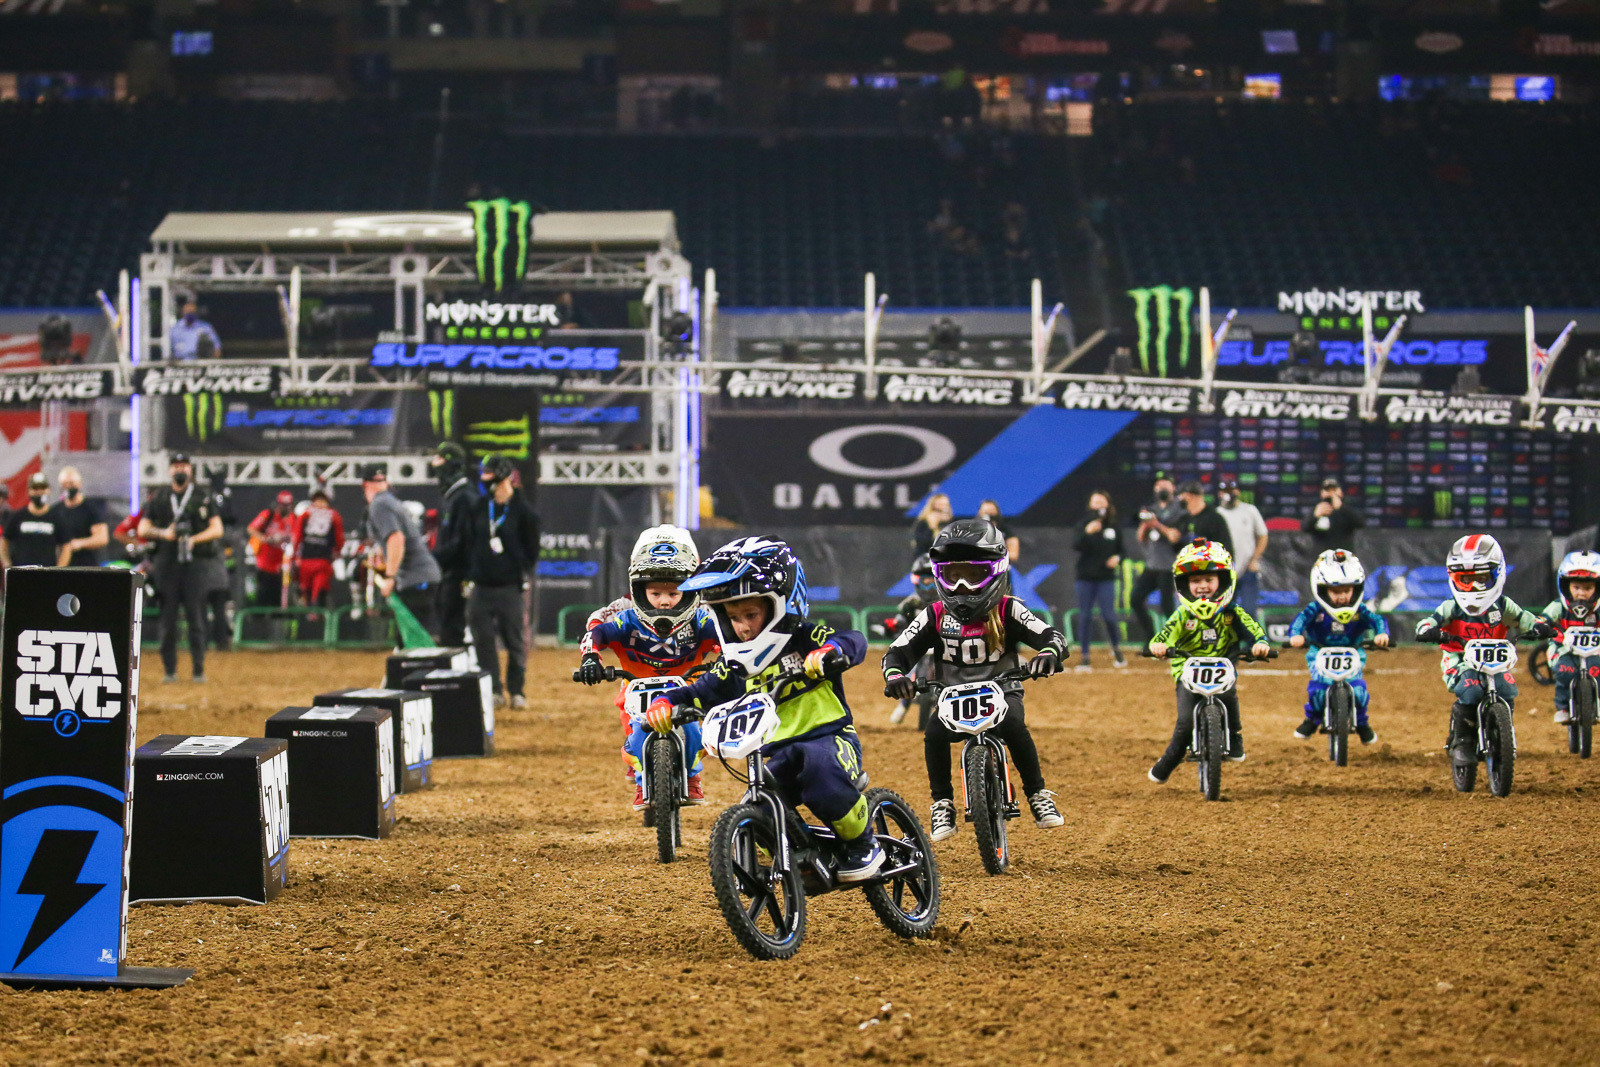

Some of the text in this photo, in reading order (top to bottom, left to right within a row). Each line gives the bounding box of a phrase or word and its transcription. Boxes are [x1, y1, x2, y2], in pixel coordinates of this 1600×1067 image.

[426, 299, 559, 326] MONSTER
[447, 326, 543, 339] ENERGY
[773, 483, 918, 509] OAKL
[1572, 634, 1600, 647] 109
[17, 630, 117, 675] STA
[1325, 657, 1352, 670] 103
[1192, 667, 1227, 684] 102
[15, 673, 121, 719] CYC
[950, 694, 995, 722] 105
[298, 730, 348, 738] ZINGGINC.COM
[718, 708, 765, 743] 107
[163, 772, 224, 782] ZINGGINC.COM
